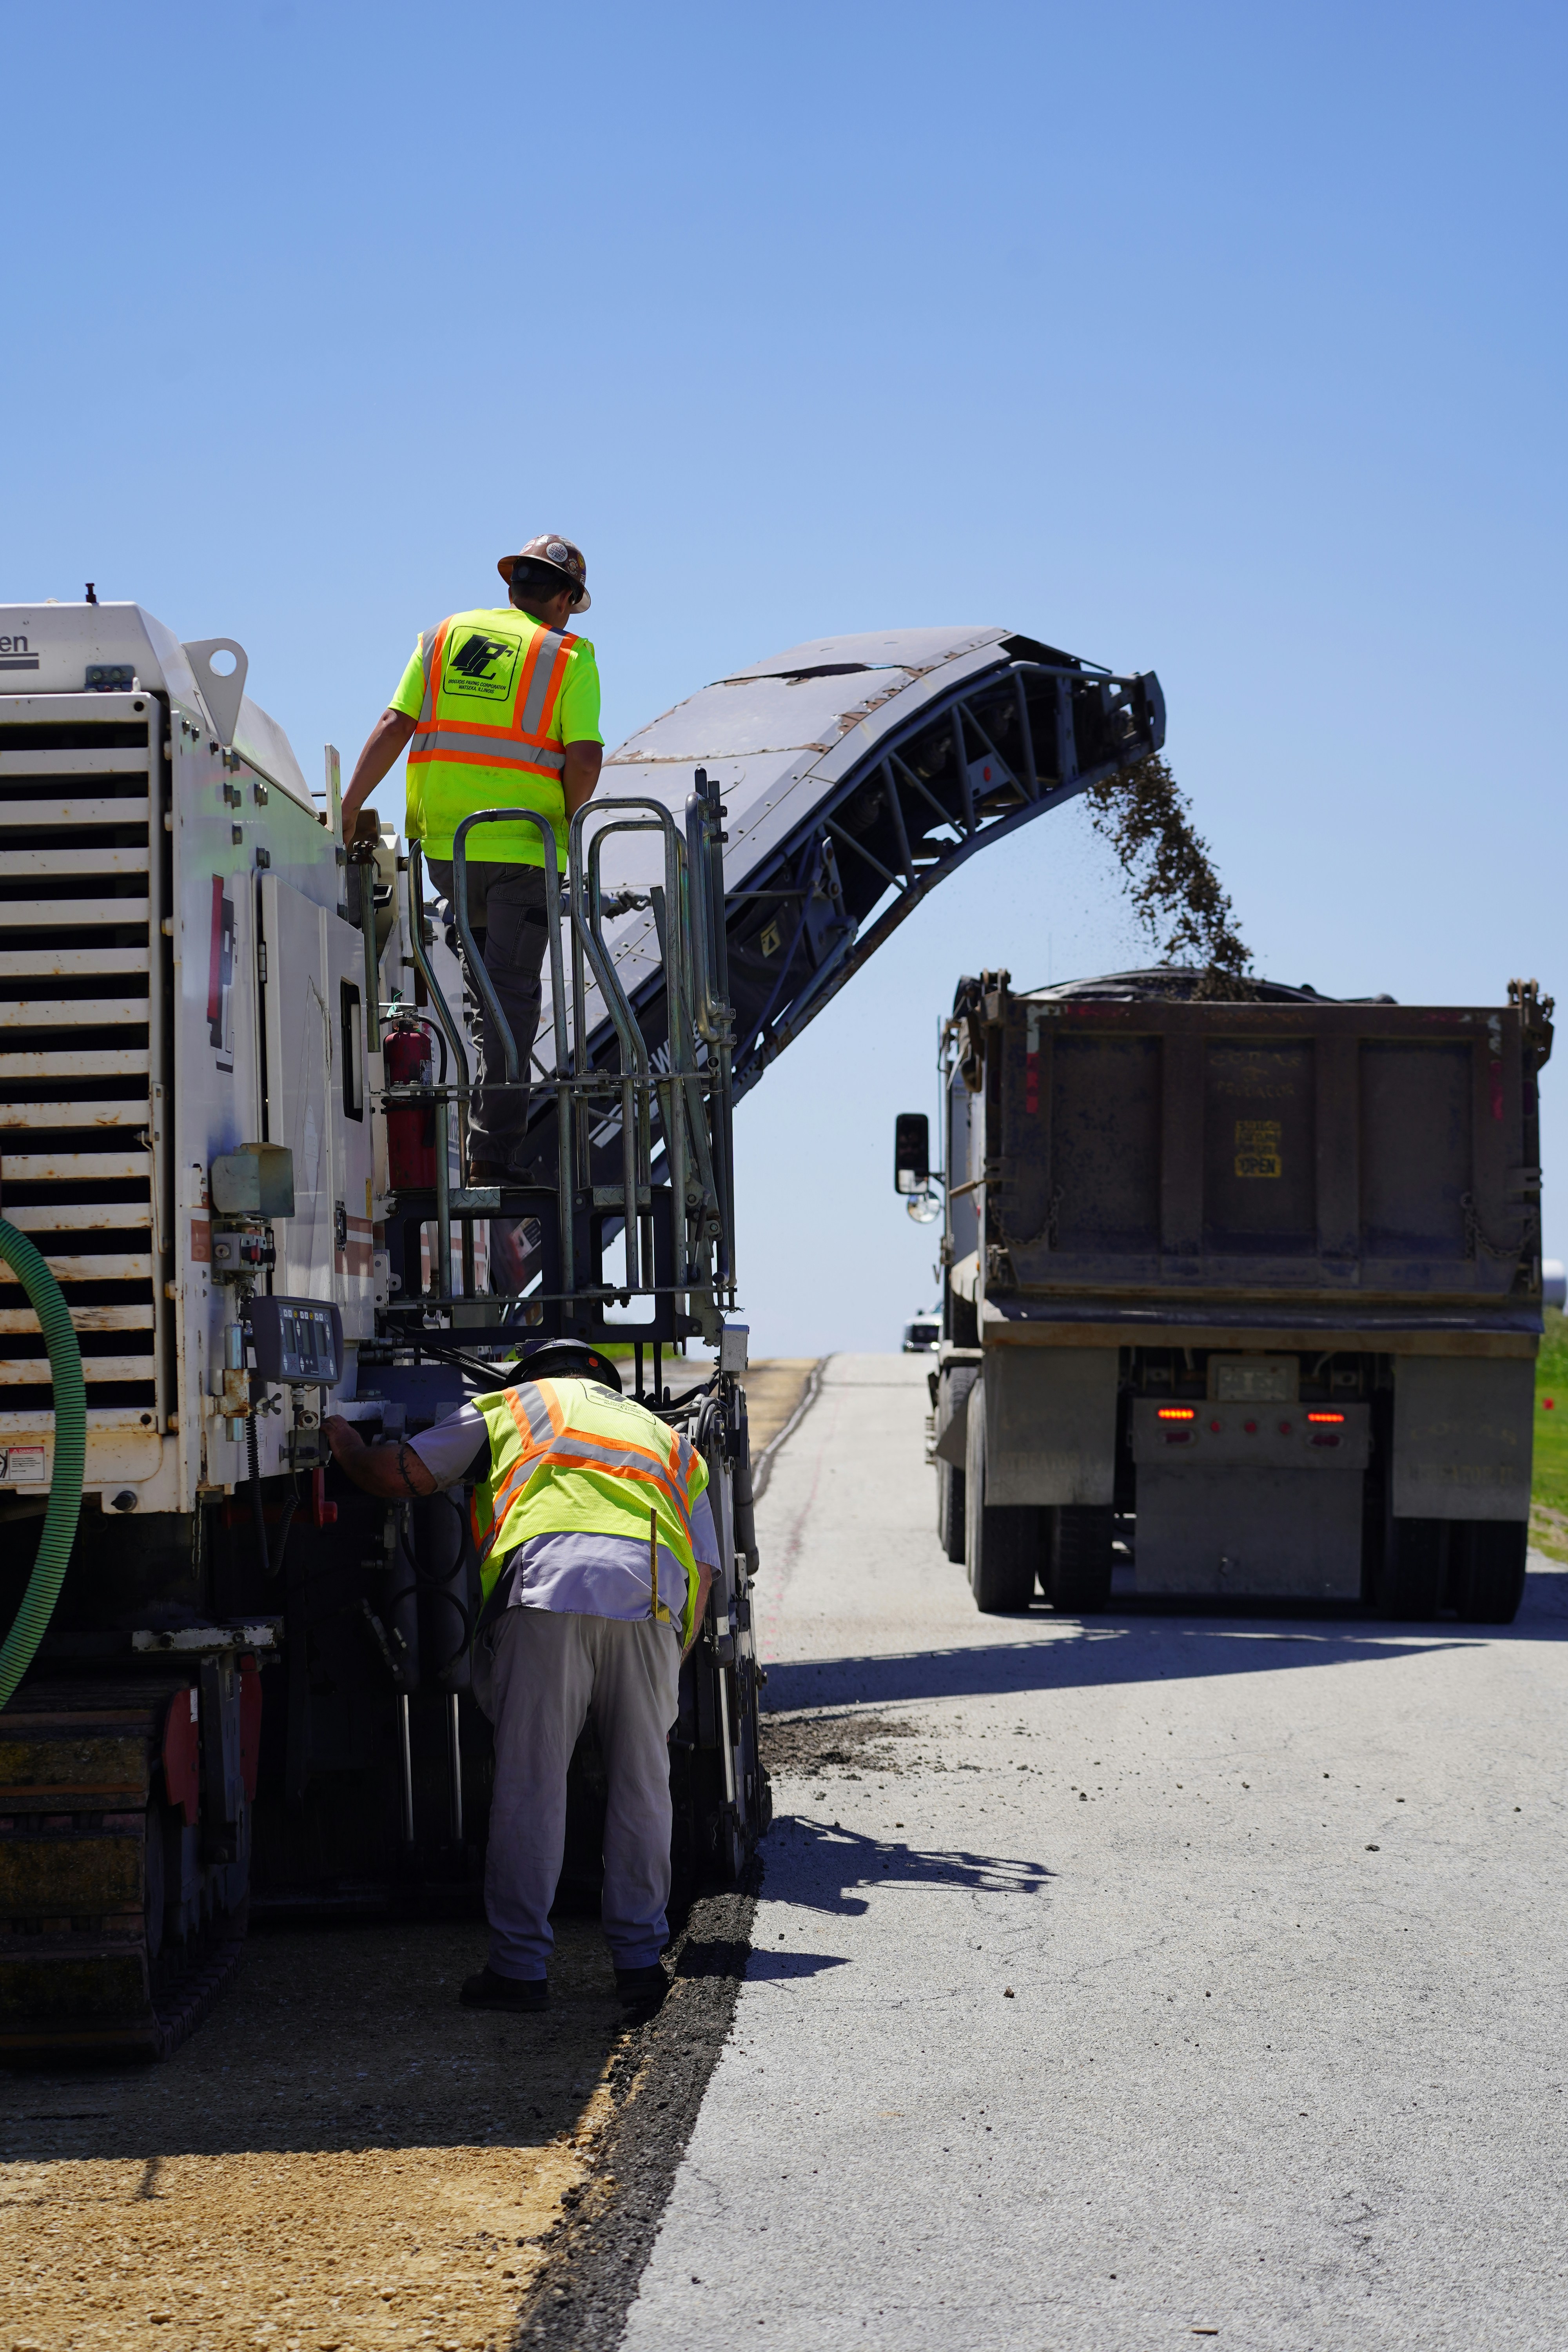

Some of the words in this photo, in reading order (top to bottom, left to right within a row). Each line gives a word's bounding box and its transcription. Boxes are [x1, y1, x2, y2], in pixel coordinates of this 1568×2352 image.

[549, 548, 564, 559] DIVIDED
[552, 544, 566, 555] UNITED
[480, 682, 506, 690] CORPORATION
[625, 1404, 652, 1419] CORPORATION
